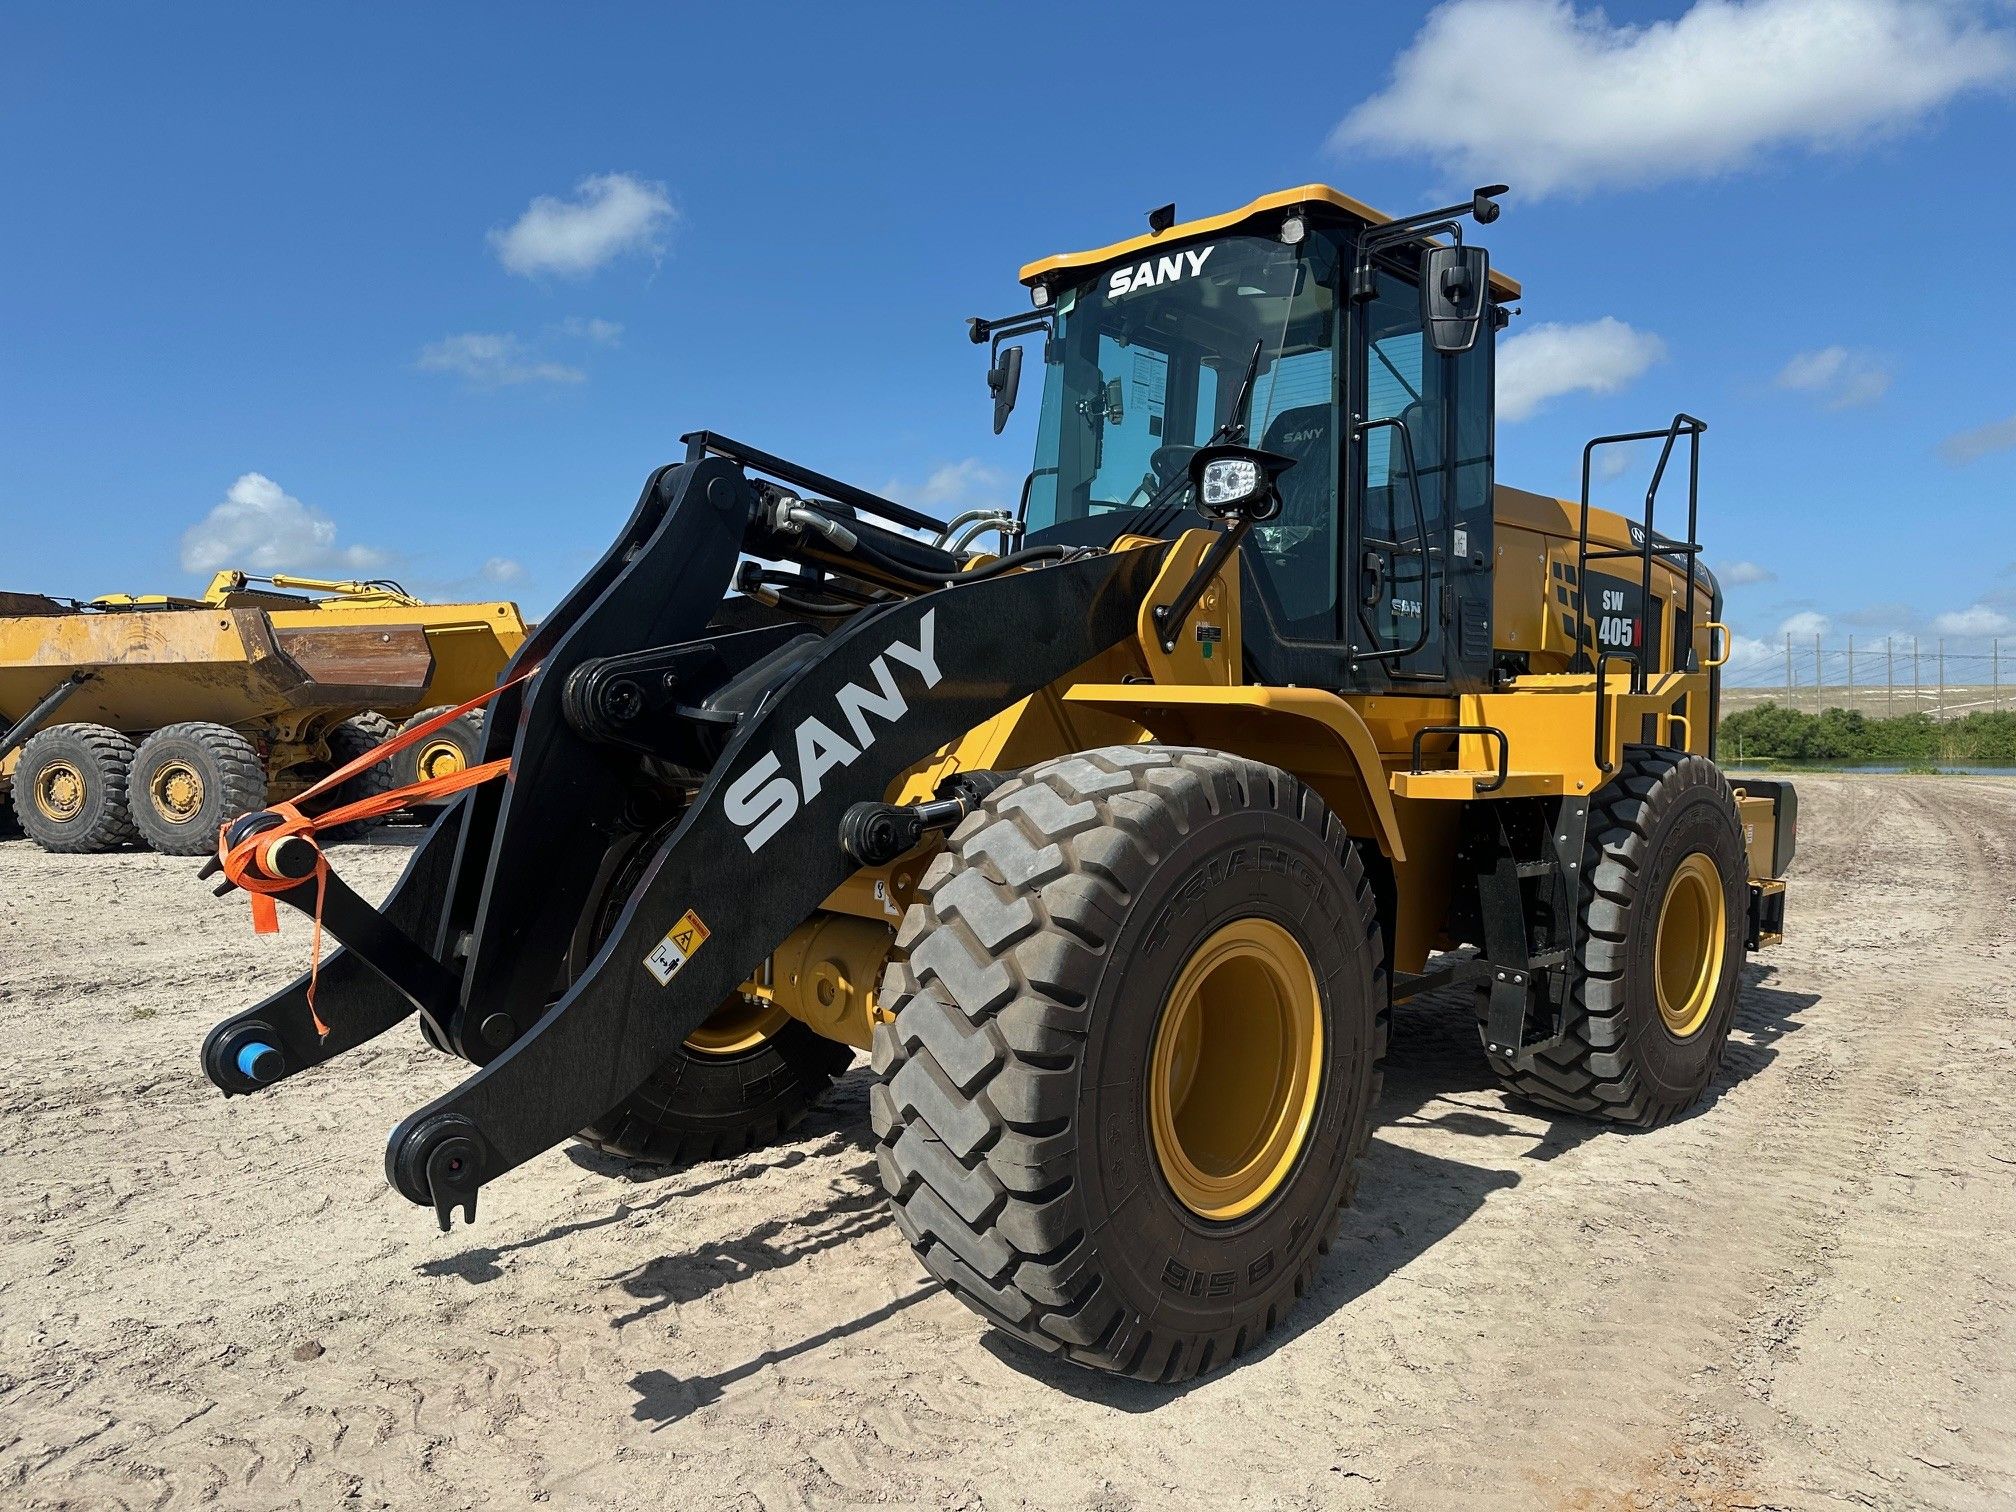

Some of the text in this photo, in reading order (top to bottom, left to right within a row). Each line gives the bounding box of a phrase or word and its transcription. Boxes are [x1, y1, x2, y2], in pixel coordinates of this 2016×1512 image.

[1107, 245, 1215, 299] SANY
[1282, 427, 1324, 443] SANY
[1391, 598, 1422, 618] SAN
[1602, 590, 1624, 611] SW
[723, 607, 943, 854] SANY
